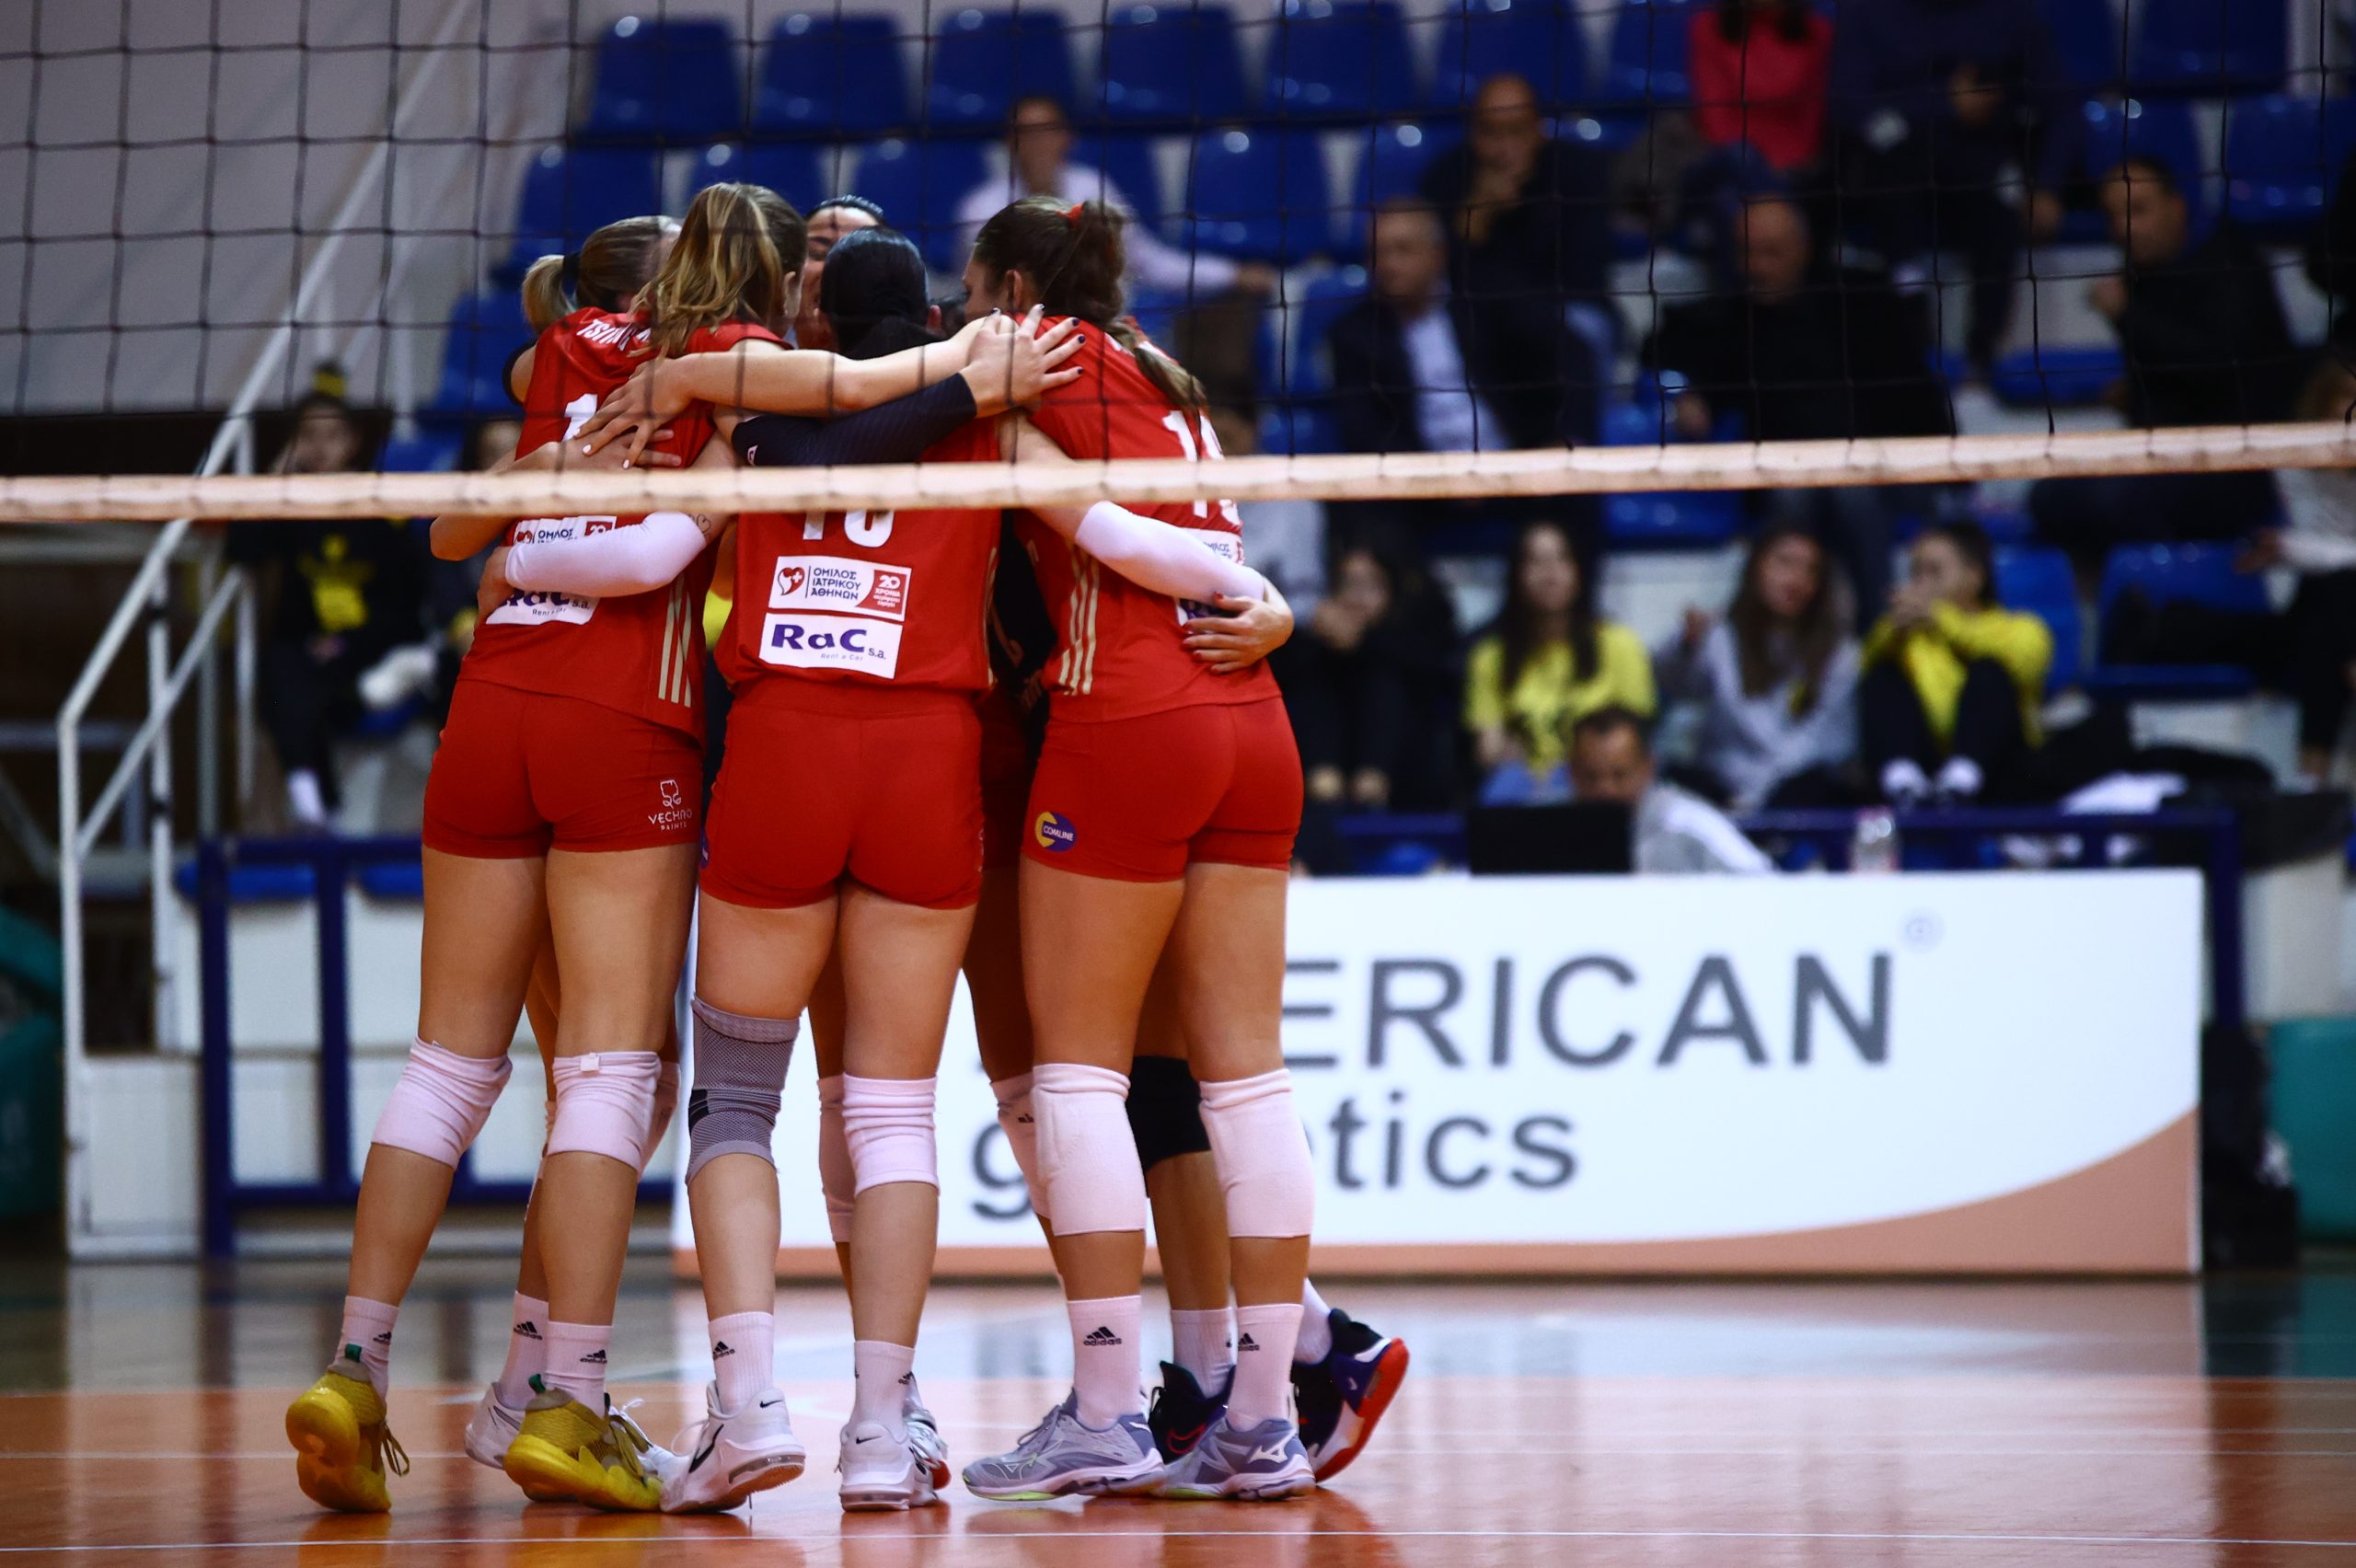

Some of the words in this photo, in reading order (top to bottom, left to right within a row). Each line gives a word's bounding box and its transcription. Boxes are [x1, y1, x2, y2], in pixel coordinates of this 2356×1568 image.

[814, 567, 857, 580] ΟΜΙΛΟΣ
[812, 577, 861, 591] ΙΑΤΡΙΚΟΥ
[878, 574, 901, 589] 20
[810, 587, 859, 600] ΑΘΗΝΩΝ
[771, 623, 867, 653] RaC
[868, 647, 887, 661] s.a.
[1043, 825, 1074, 842] COMLINE
[1083, 1336, 1123, 1346] adidas
